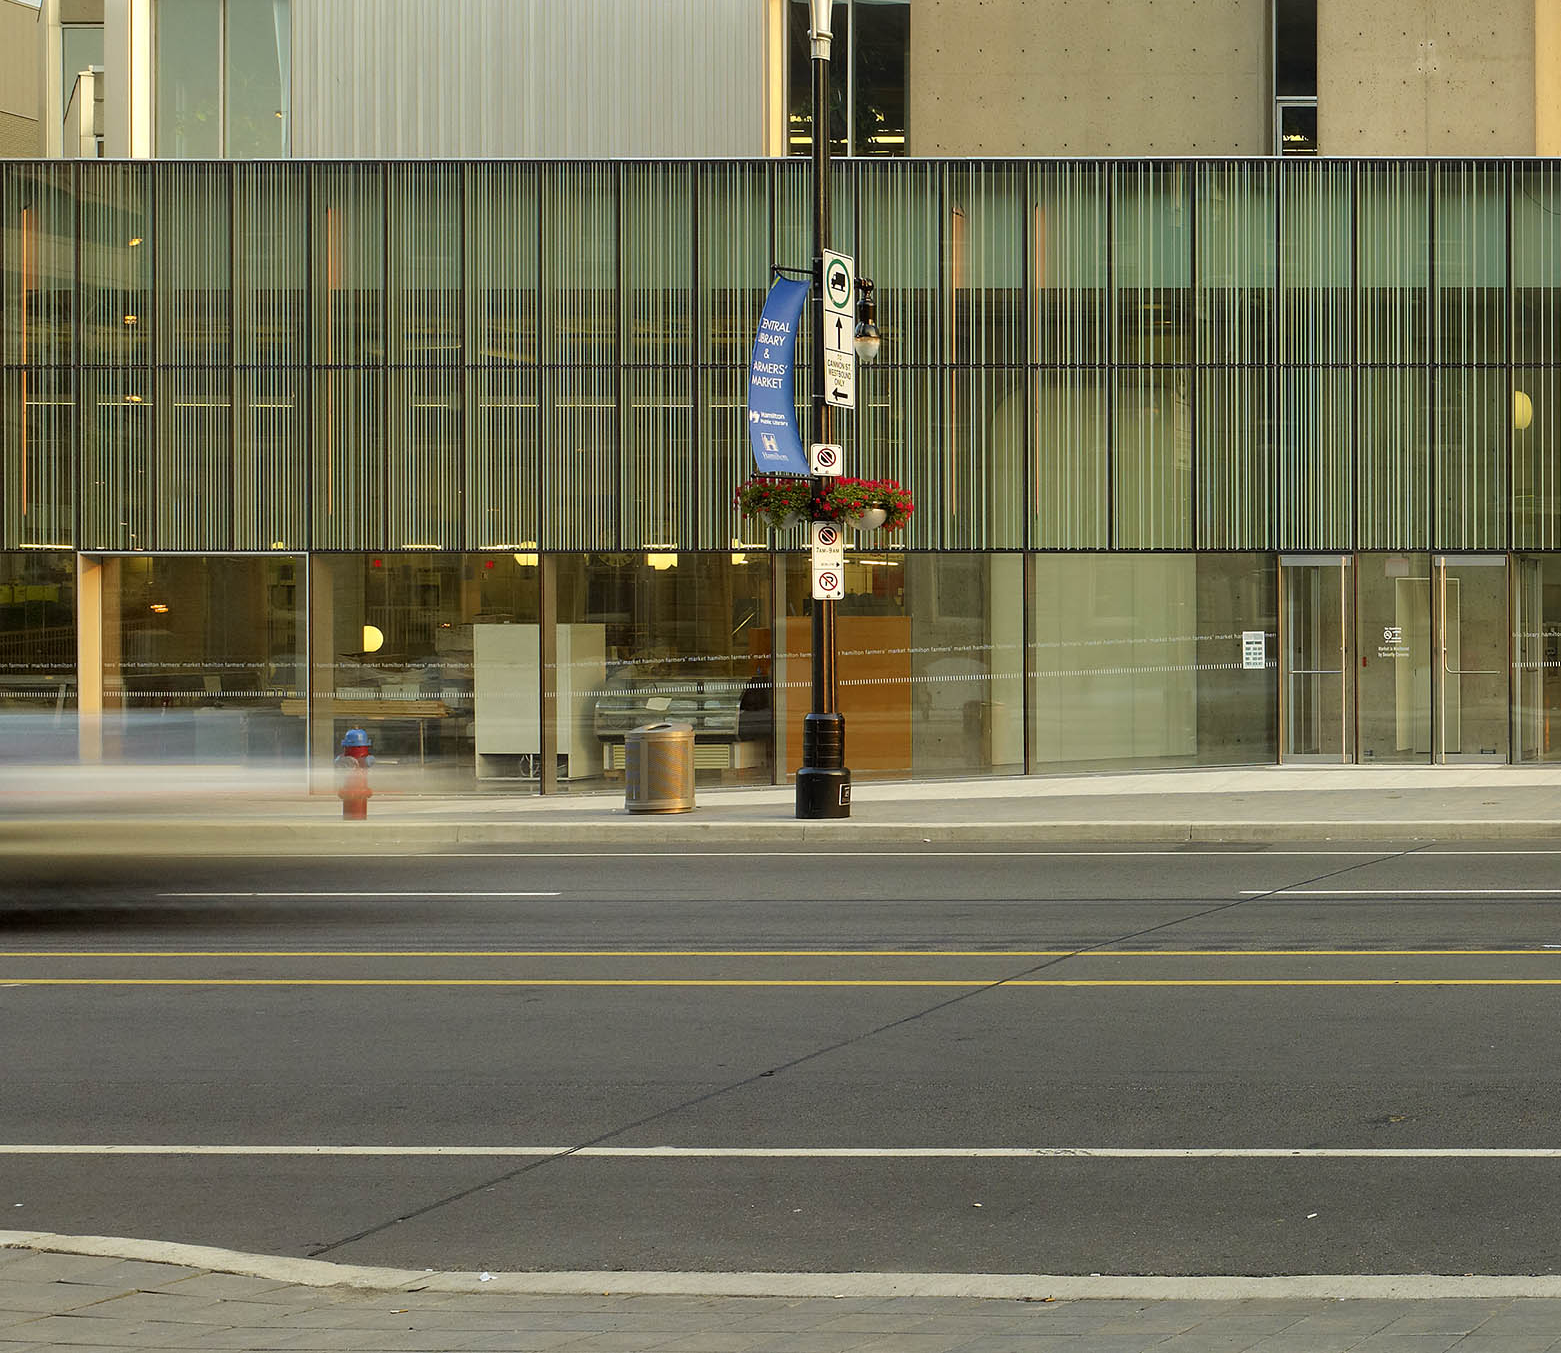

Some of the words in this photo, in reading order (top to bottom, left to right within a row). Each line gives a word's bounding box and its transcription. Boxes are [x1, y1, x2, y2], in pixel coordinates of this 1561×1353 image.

[761, 318, 791, 333] ENTRAL
[763, 348, 770, 359] &
[753, 360, 788, 375] ARMERS'
[751, 374, 783, 389] MARKET
